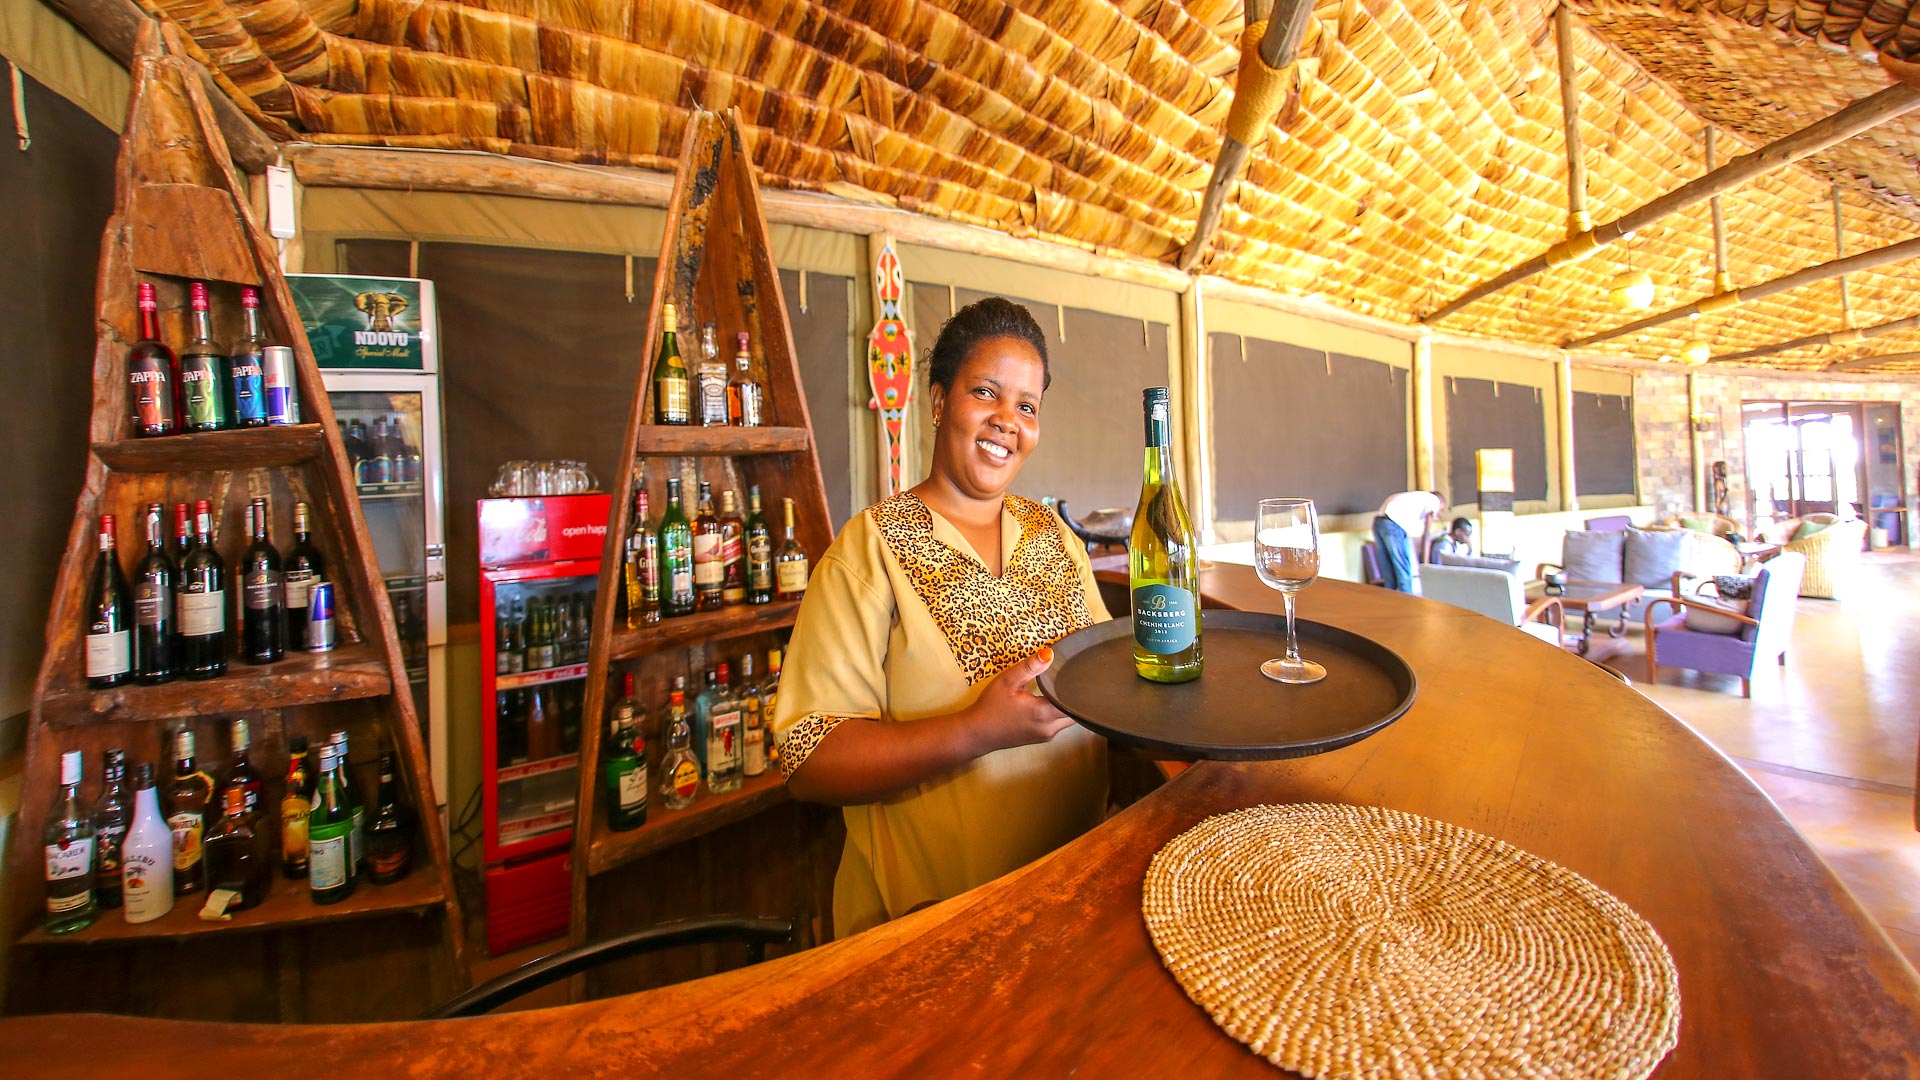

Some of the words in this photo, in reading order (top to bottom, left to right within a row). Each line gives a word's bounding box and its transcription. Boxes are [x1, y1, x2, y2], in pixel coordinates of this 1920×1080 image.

[354, 331, 409, 346] NDOVU
[130, 371, 166, 383] ZAPPA
[182, 370, 216, 383] ZAPPA
[232, 365, 263, 378] ZAPPA
[562, 525, 586, 538] open
[1137, 608, 1186, 618] BACKSBERG
[1139, 619, 1163, 628] CHENIN
